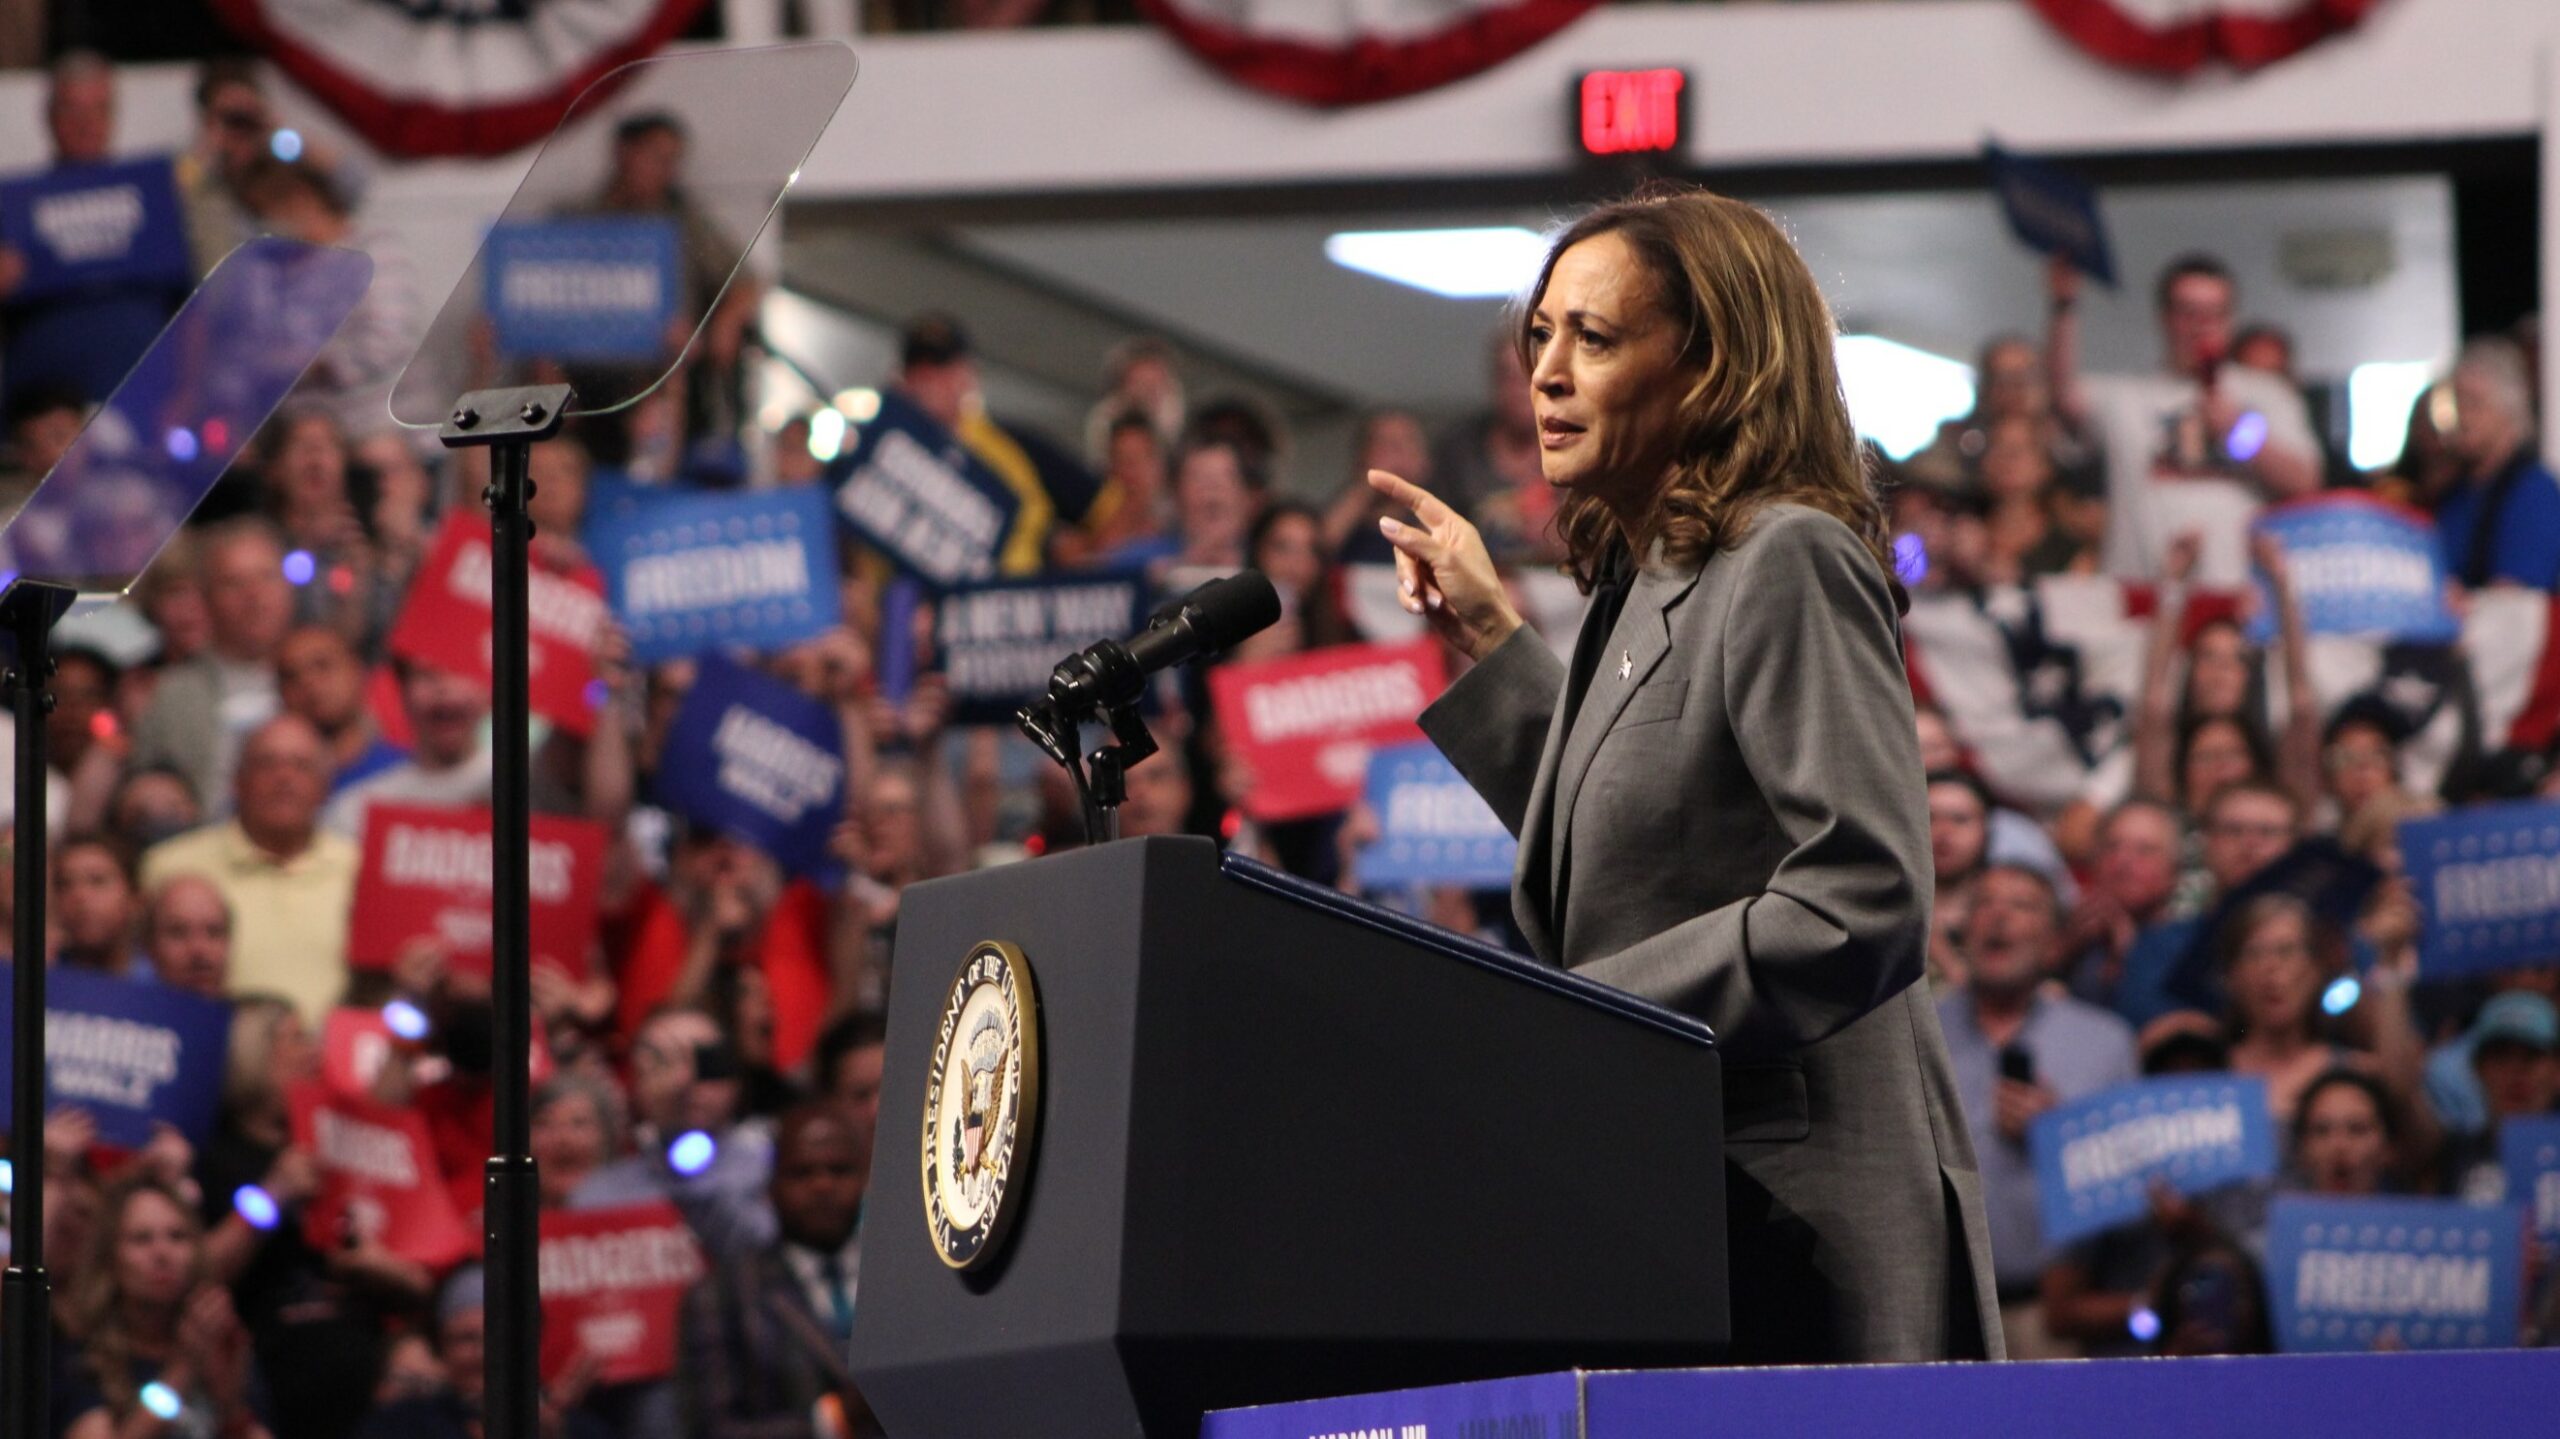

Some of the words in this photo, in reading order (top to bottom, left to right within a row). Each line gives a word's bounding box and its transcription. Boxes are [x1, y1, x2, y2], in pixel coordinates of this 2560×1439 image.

[624, 538, 809, 615] FREEDOM
[968, 958, 983, 987] OF
[983, 955, 1001, 981] THE
[1001, 966, 1021, 1095] UNITED
[927, 977, 965, 1171] PRESIDENT
[980, 1119, 1016, 1241] STATES
[2061, 1104, 2242, 1192] FREEDOM
[2296, 1252, 2490, 1316] FREEDOM
